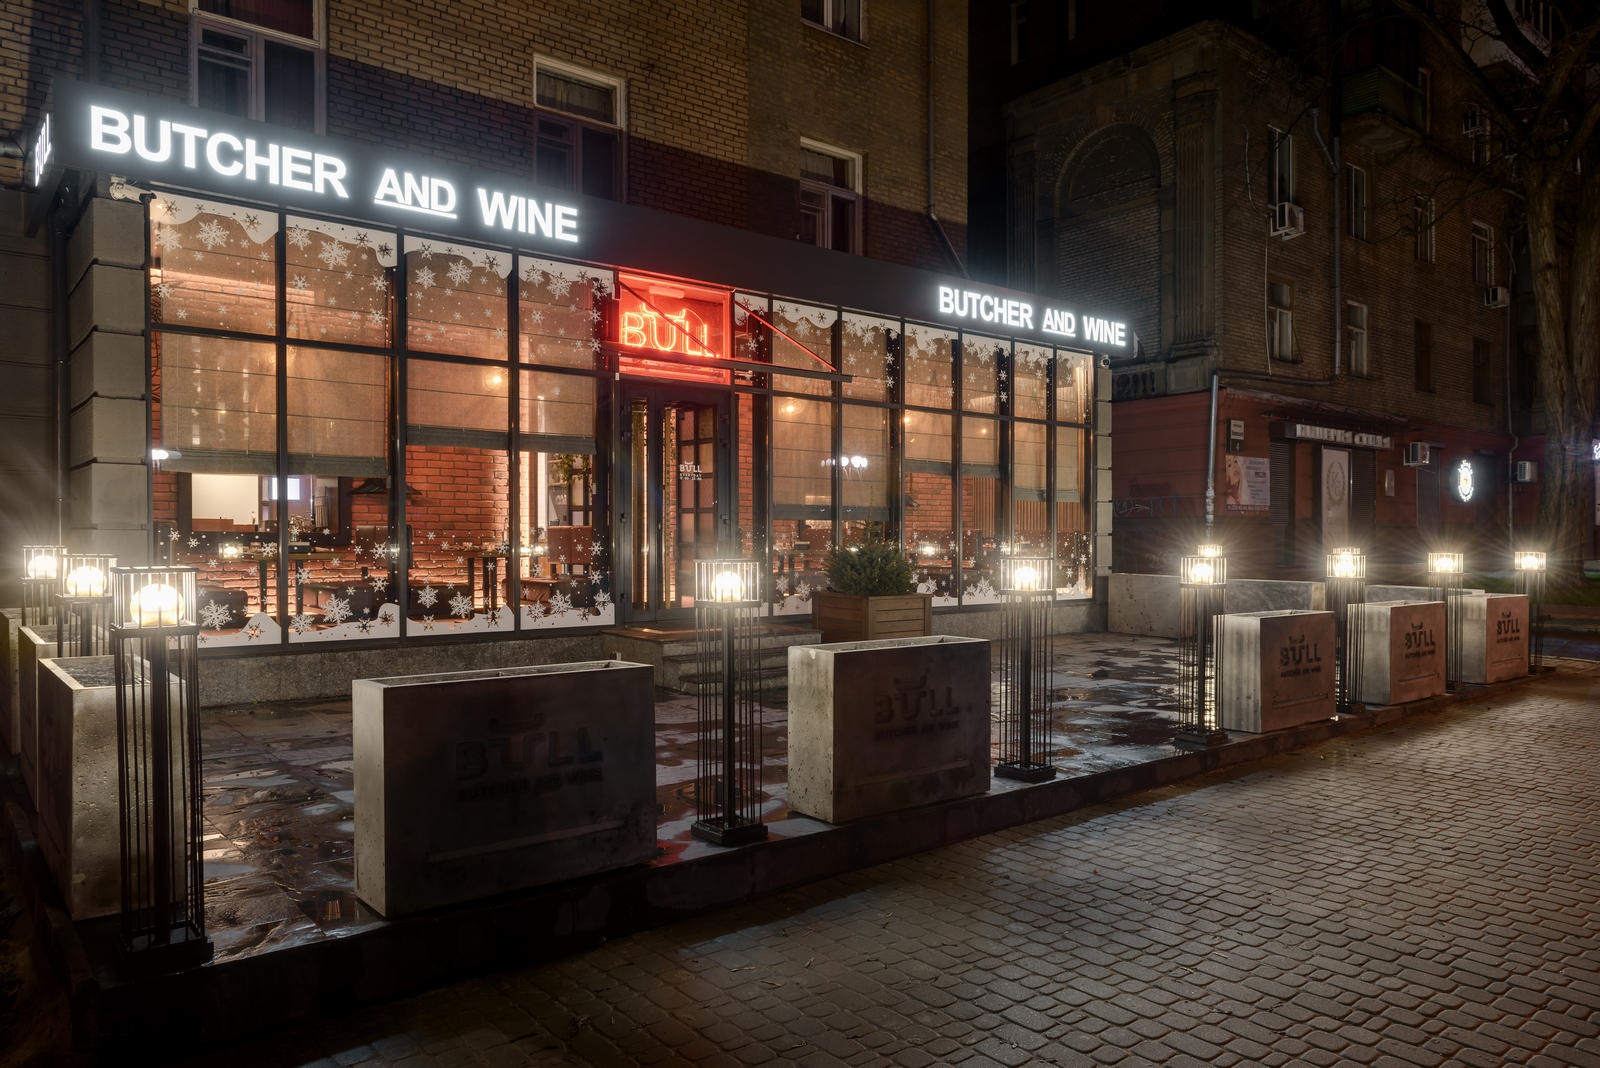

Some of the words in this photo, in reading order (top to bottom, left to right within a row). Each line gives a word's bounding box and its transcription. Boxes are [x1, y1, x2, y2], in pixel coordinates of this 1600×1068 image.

[90, 105, 349, 198] BUTCHER
[374, 168, 457, 219] AND
[477, 188, 579, 243] WINE
[939, 286, 1034, 329] BUTCHER
[1042, 308, 1076, 337] AND
[1083, 315, 1126, 347] WINE
[622, 311, 720, 358] BULL
[680, 464, 702, 473] BULL
[1405, 630, 1435, 649] BULL
[1496, 619, 1520, 635] BULL
[1281, 644, 1321, 666] BULL
[875, 686, 960, 724] BULL
[876, 725, 918, 740] BUTCHER
[938, 720, 959, 731] WINE
[455, 727, 603, 783] BULL
